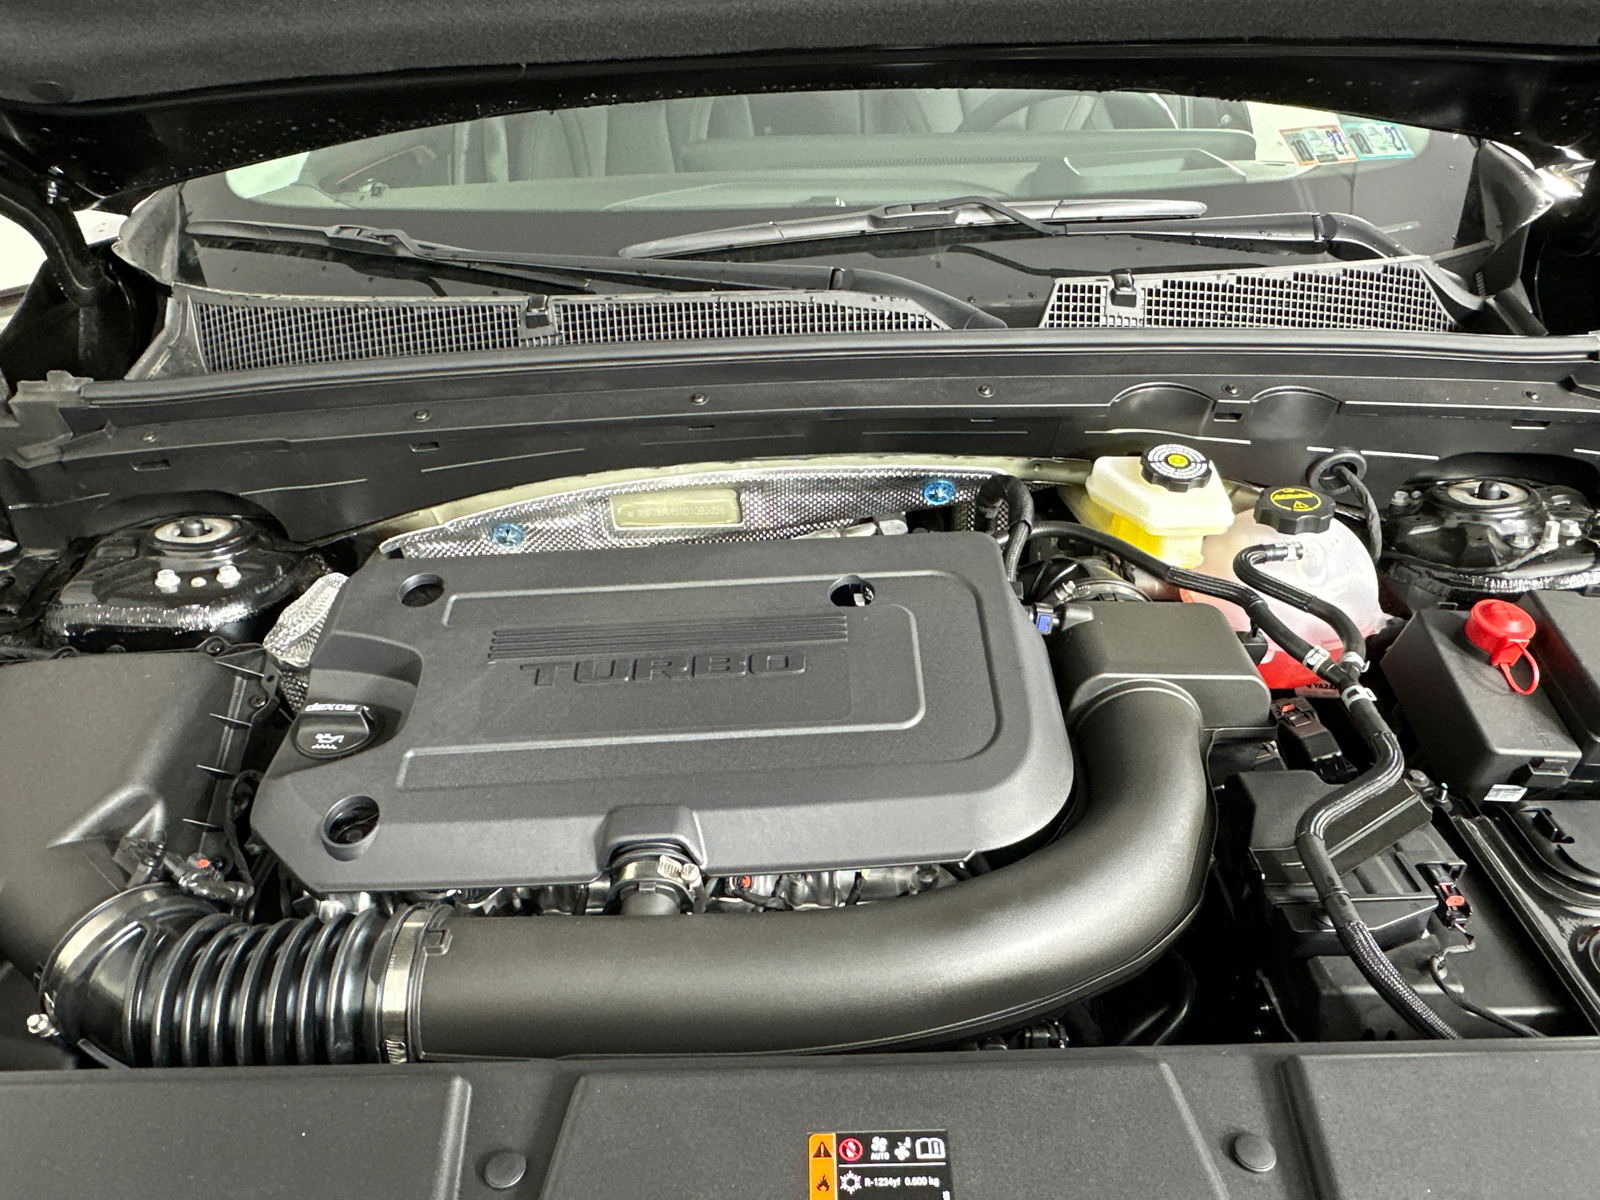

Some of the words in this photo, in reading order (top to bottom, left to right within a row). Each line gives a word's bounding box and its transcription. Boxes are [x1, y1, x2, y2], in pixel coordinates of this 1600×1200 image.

[519, 652, 808, 687] TURBO
[1313, 682, 1337, 690] YAZA
[305, 703, 358, 711] dexos
[870, 1151, 890, 1161] AUTO
[865, 1177, 900, 1187] R-1234yf
[929, 1177, 940, 1187] kg
